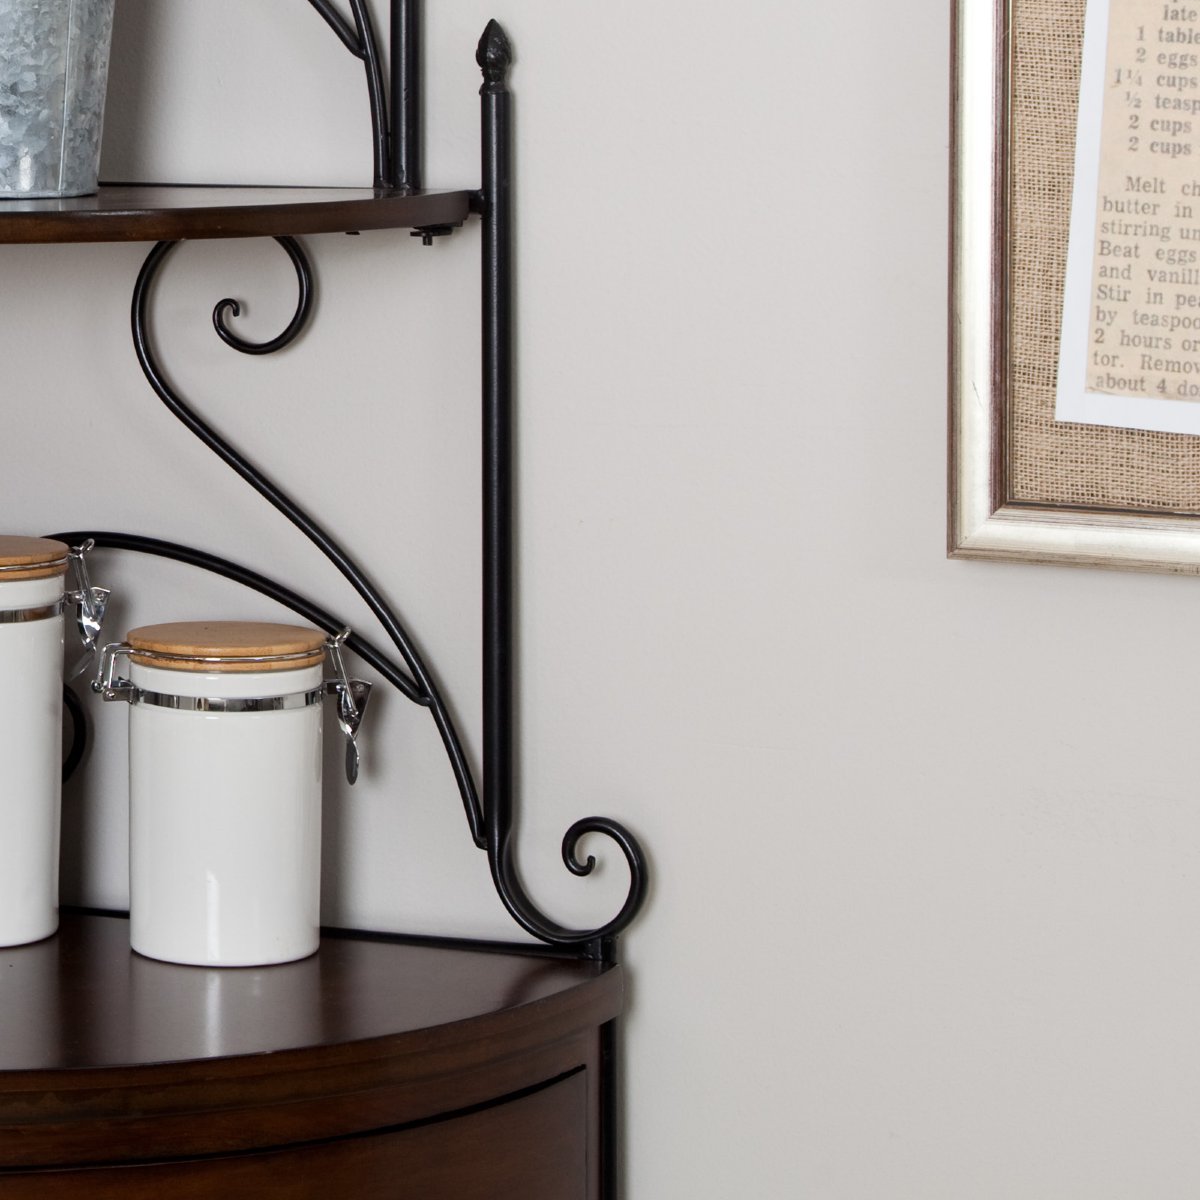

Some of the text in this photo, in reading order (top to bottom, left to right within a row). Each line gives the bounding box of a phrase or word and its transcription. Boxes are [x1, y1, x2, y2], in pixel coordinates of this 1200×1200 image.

[1136, 25, 1145, 42] 1
[1135, 47, 1198, 70] 2 eggs
[1156, 74, 1198, 92] cups
[1155, 94, 1200, 115] teasp
[1128, 114, 1192, 137] 2 cups
[1128, 136, 1192, 159] 2 cups
[1125, 176, 1166, 194] Melt
[1102, 195, 1193, 218] butter in
[1100, 219, 1171, 242] stirring
[1098, 240, 1197, 266] Beat eggs
[1098, 264, 1132, 280] and
[1096, 284, 1200, 310] Stir in pe
[1095, 305, 1118, 326] by
[1094, 328, 1200, 352] 2 hours or
[1093, 350, 1125, 368] tor.
[1095, 373, 1200, 397] about 4 do
